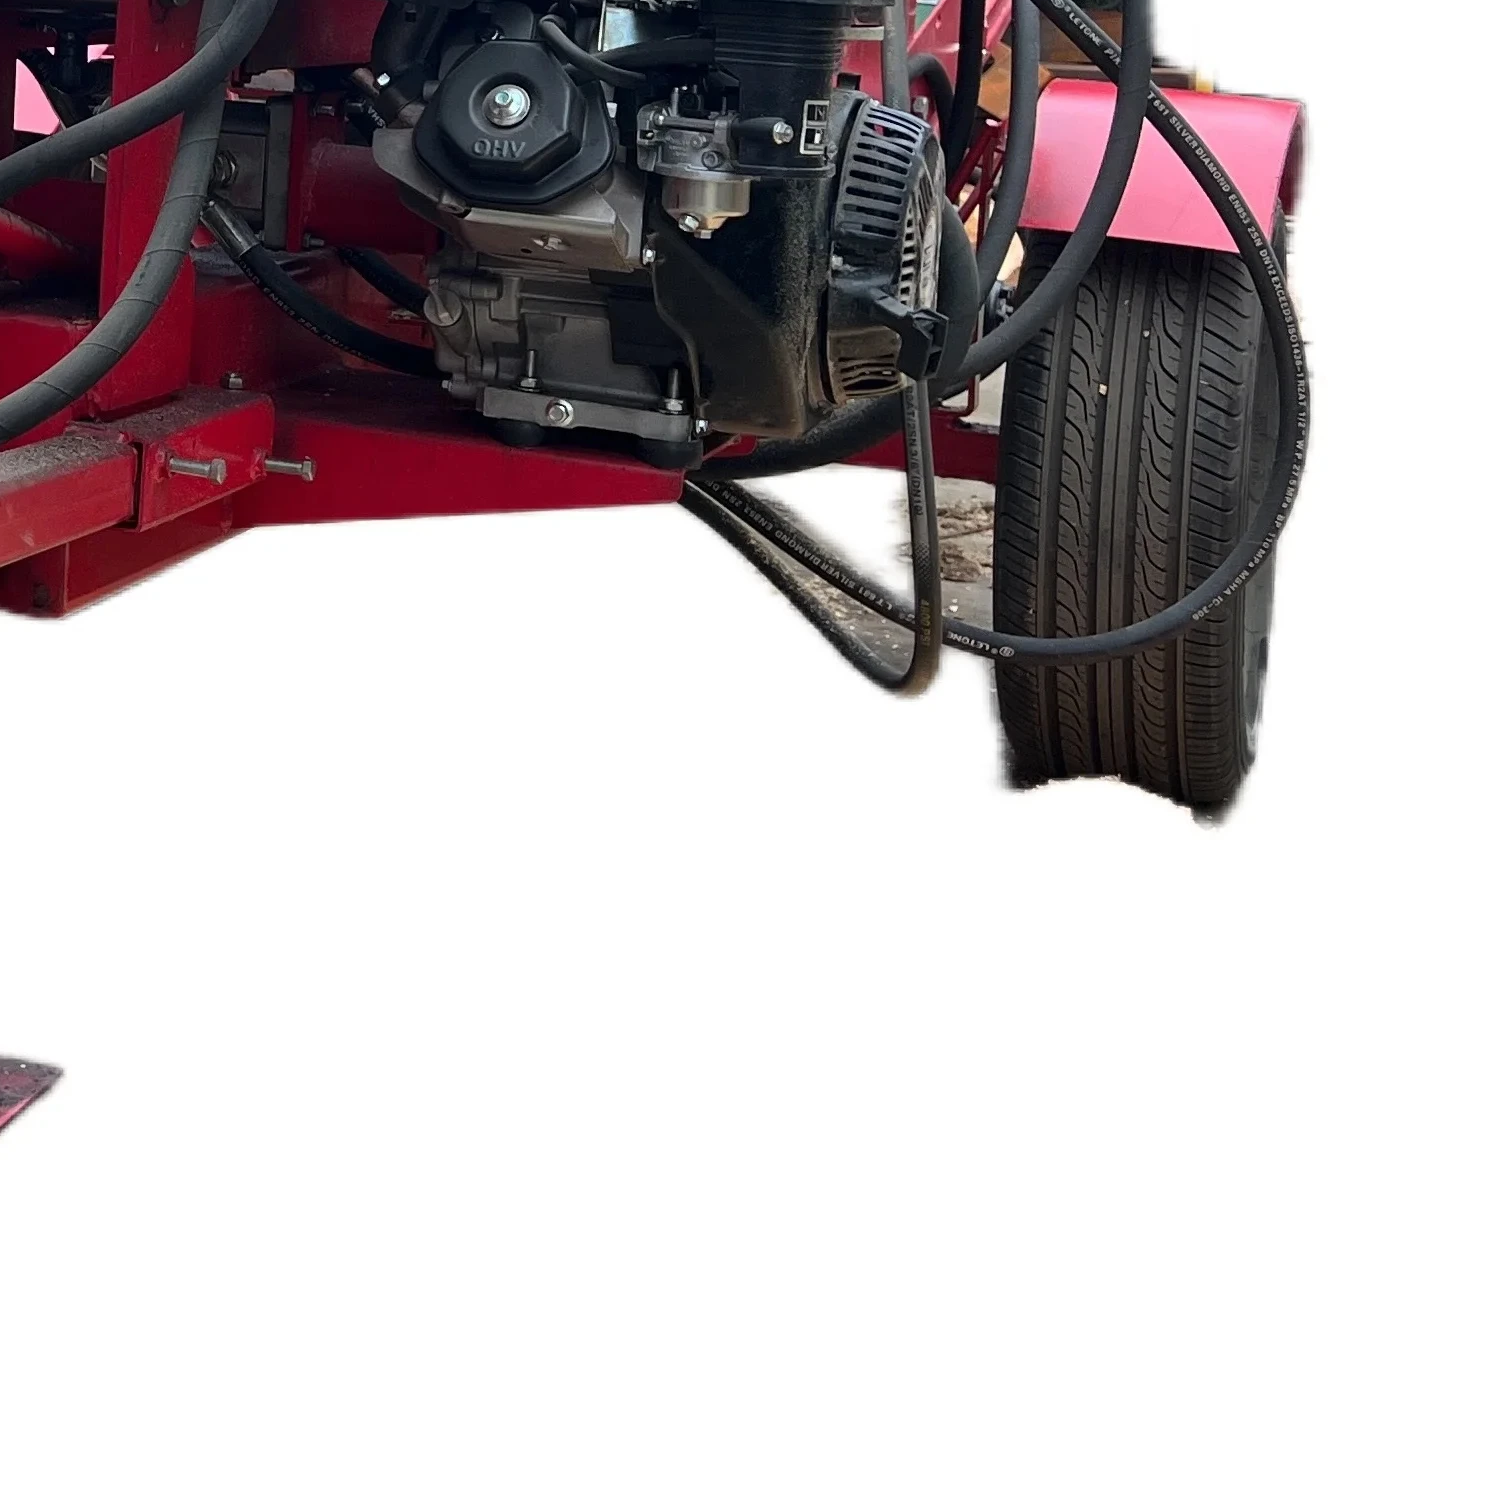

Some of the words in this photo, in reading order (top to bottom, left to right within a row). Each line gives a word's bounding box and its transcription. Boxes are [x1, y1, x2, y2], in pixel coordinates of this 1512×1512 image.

[473, 138, 526, 159] OHV
[1069, 12, 1103, 47] LETONE
[1169, 116, 1199, 149] SILVER
[1195, 147, 1231, 192] DIAMOND
[1259, 249, 1277, 277] DN12
[775, 529, 821, 566] DIAMOND
[947, 631, 990, 651] LETONE
